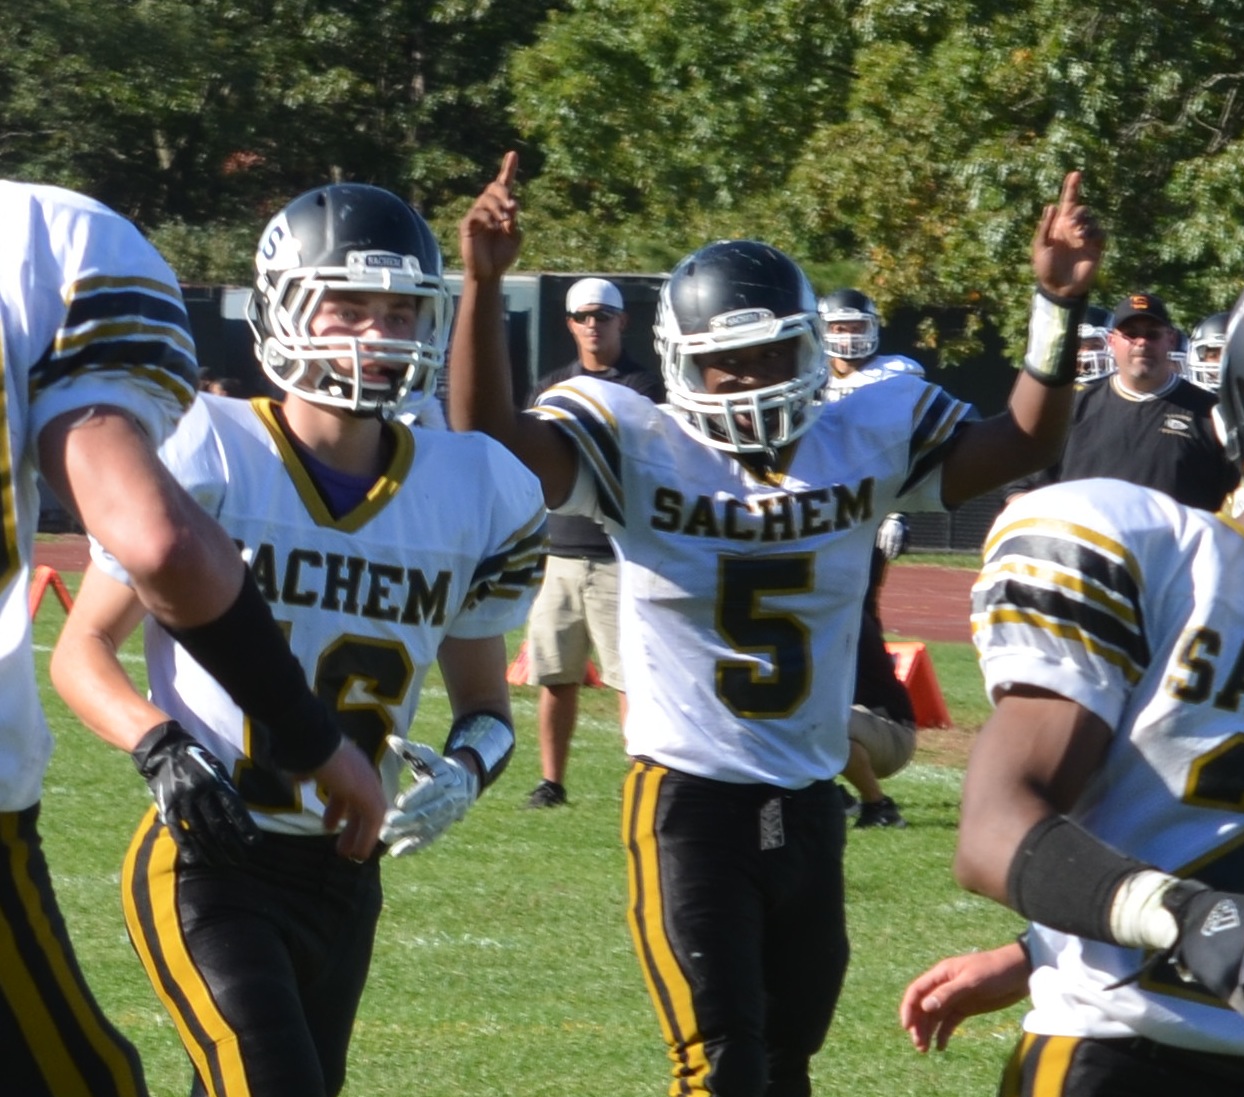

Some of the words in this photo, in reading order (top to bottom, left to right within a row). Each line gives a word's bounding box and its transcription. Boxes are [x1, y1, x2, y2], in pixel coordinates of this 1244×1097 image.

[262, 225, 285, 260] S
[651, 477, 875, 542] SACHEM
[233, 538, 452, 627] ACHEM
[714, 552, 816, 721] 5
